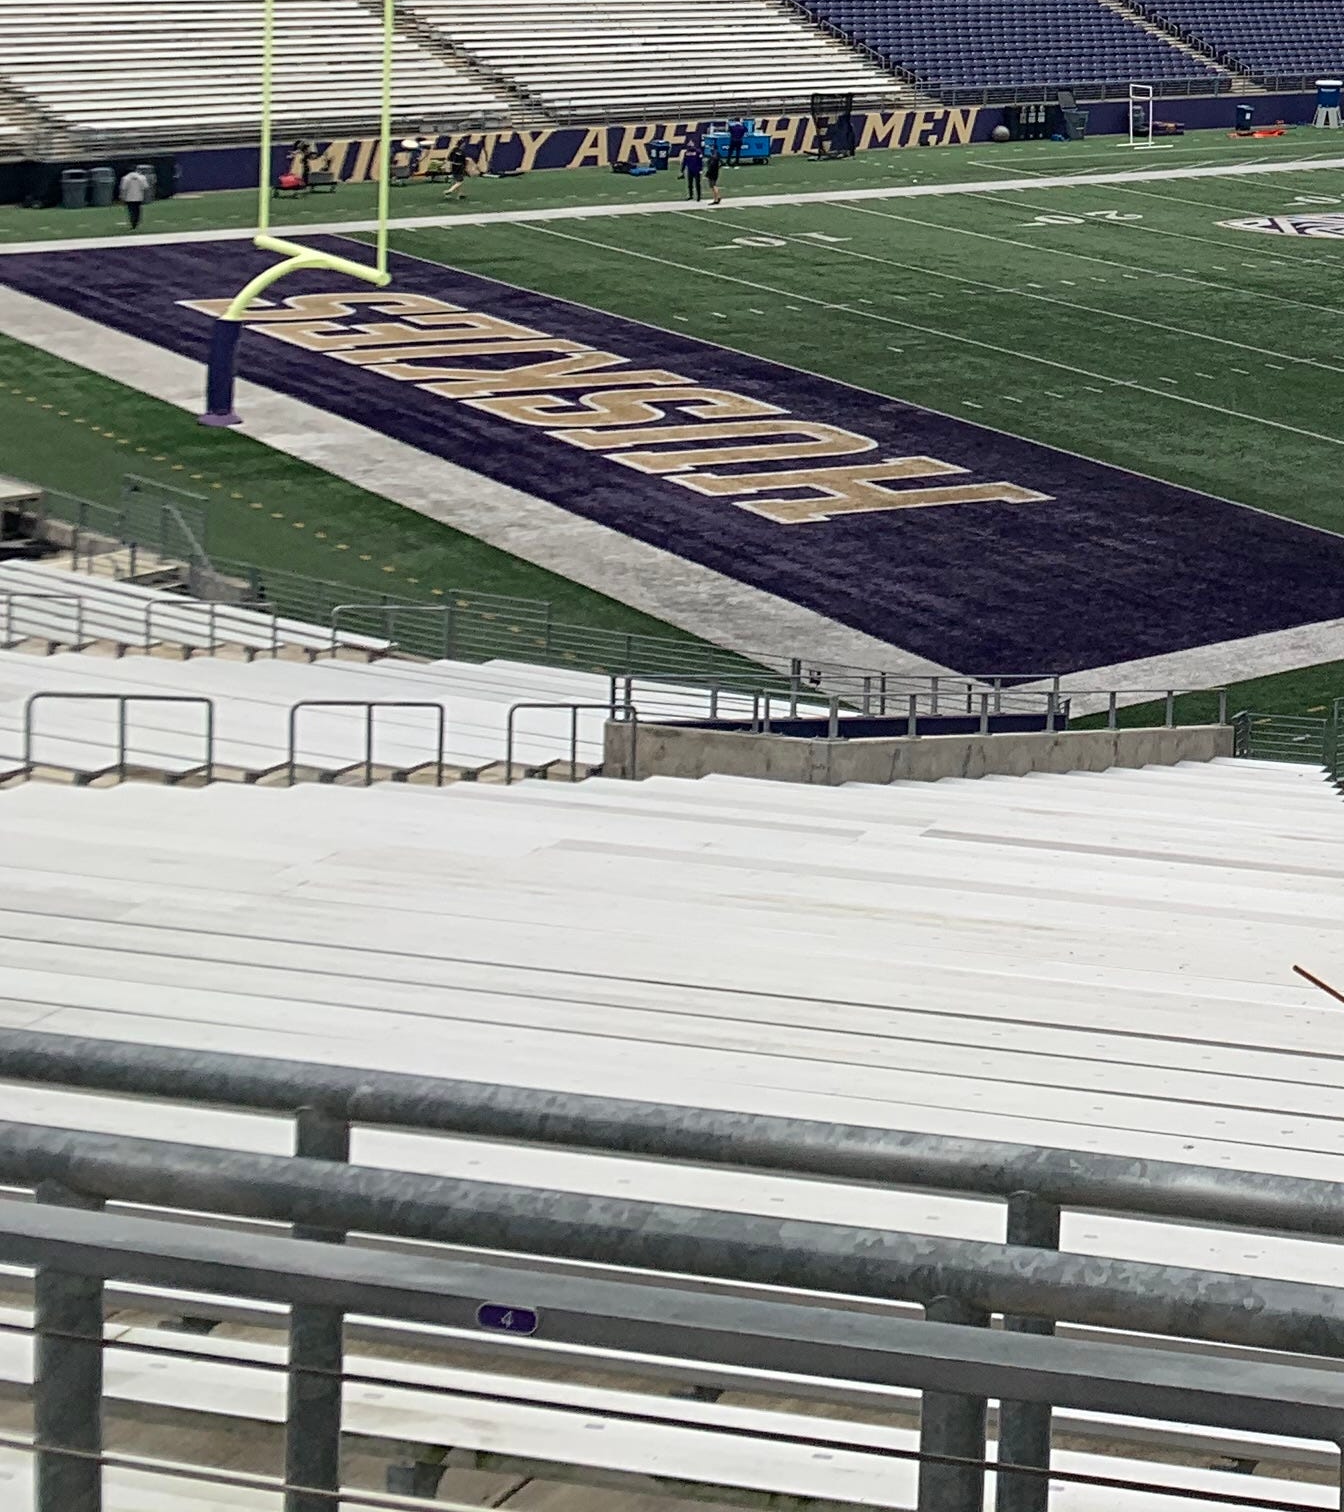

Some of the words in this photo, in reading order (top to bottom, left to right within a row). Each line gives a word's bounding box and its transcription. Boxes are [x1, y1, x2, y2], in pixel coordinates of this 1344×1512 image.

[849, 107, 980, 151] MEN
[174, 291, 1056, 524] HUSKIES
[501, 1310, 514, 1329] 4
